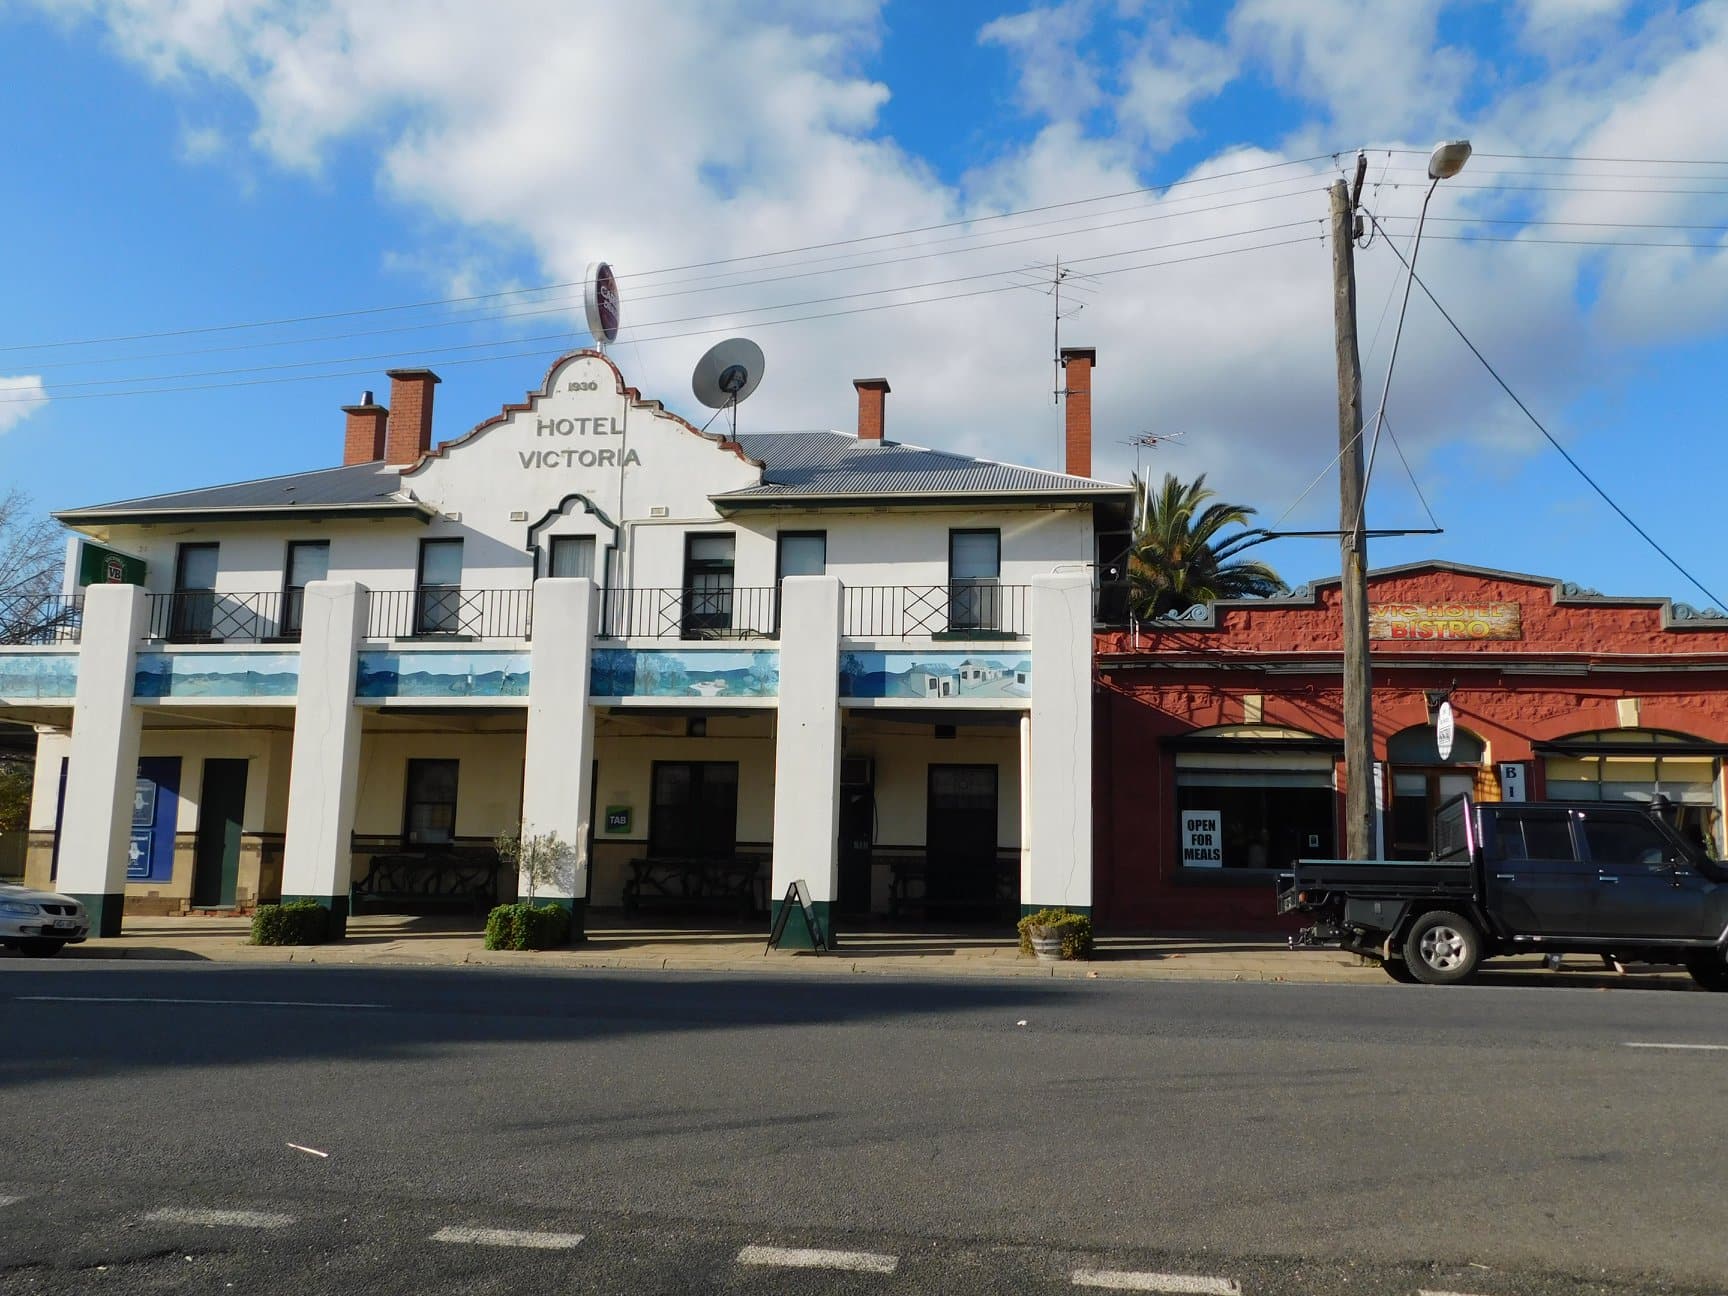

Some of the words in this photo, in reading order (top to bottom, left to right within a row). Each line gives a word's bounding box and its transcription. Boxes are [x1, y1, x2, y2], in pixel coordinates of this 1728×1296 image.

[568, 381, 598, 392] 1930
[537, 417, 623, 437] HOTEL
[518, 448, 641, 469] VICTORIA
[109, 567, 121, 579] VB
[1374, 604, 1419, 617] VIC
[1426, 604, 1504, 617] HOTEL
[1391, 620, 1490, 639] BISTRO
[610, 816, 627, 825] TAB
[1187, 819, 1216, 832] OPEN
[1191, 834, 1213, 846] FOR
[1184, 848, 1221, 861] MEALS
